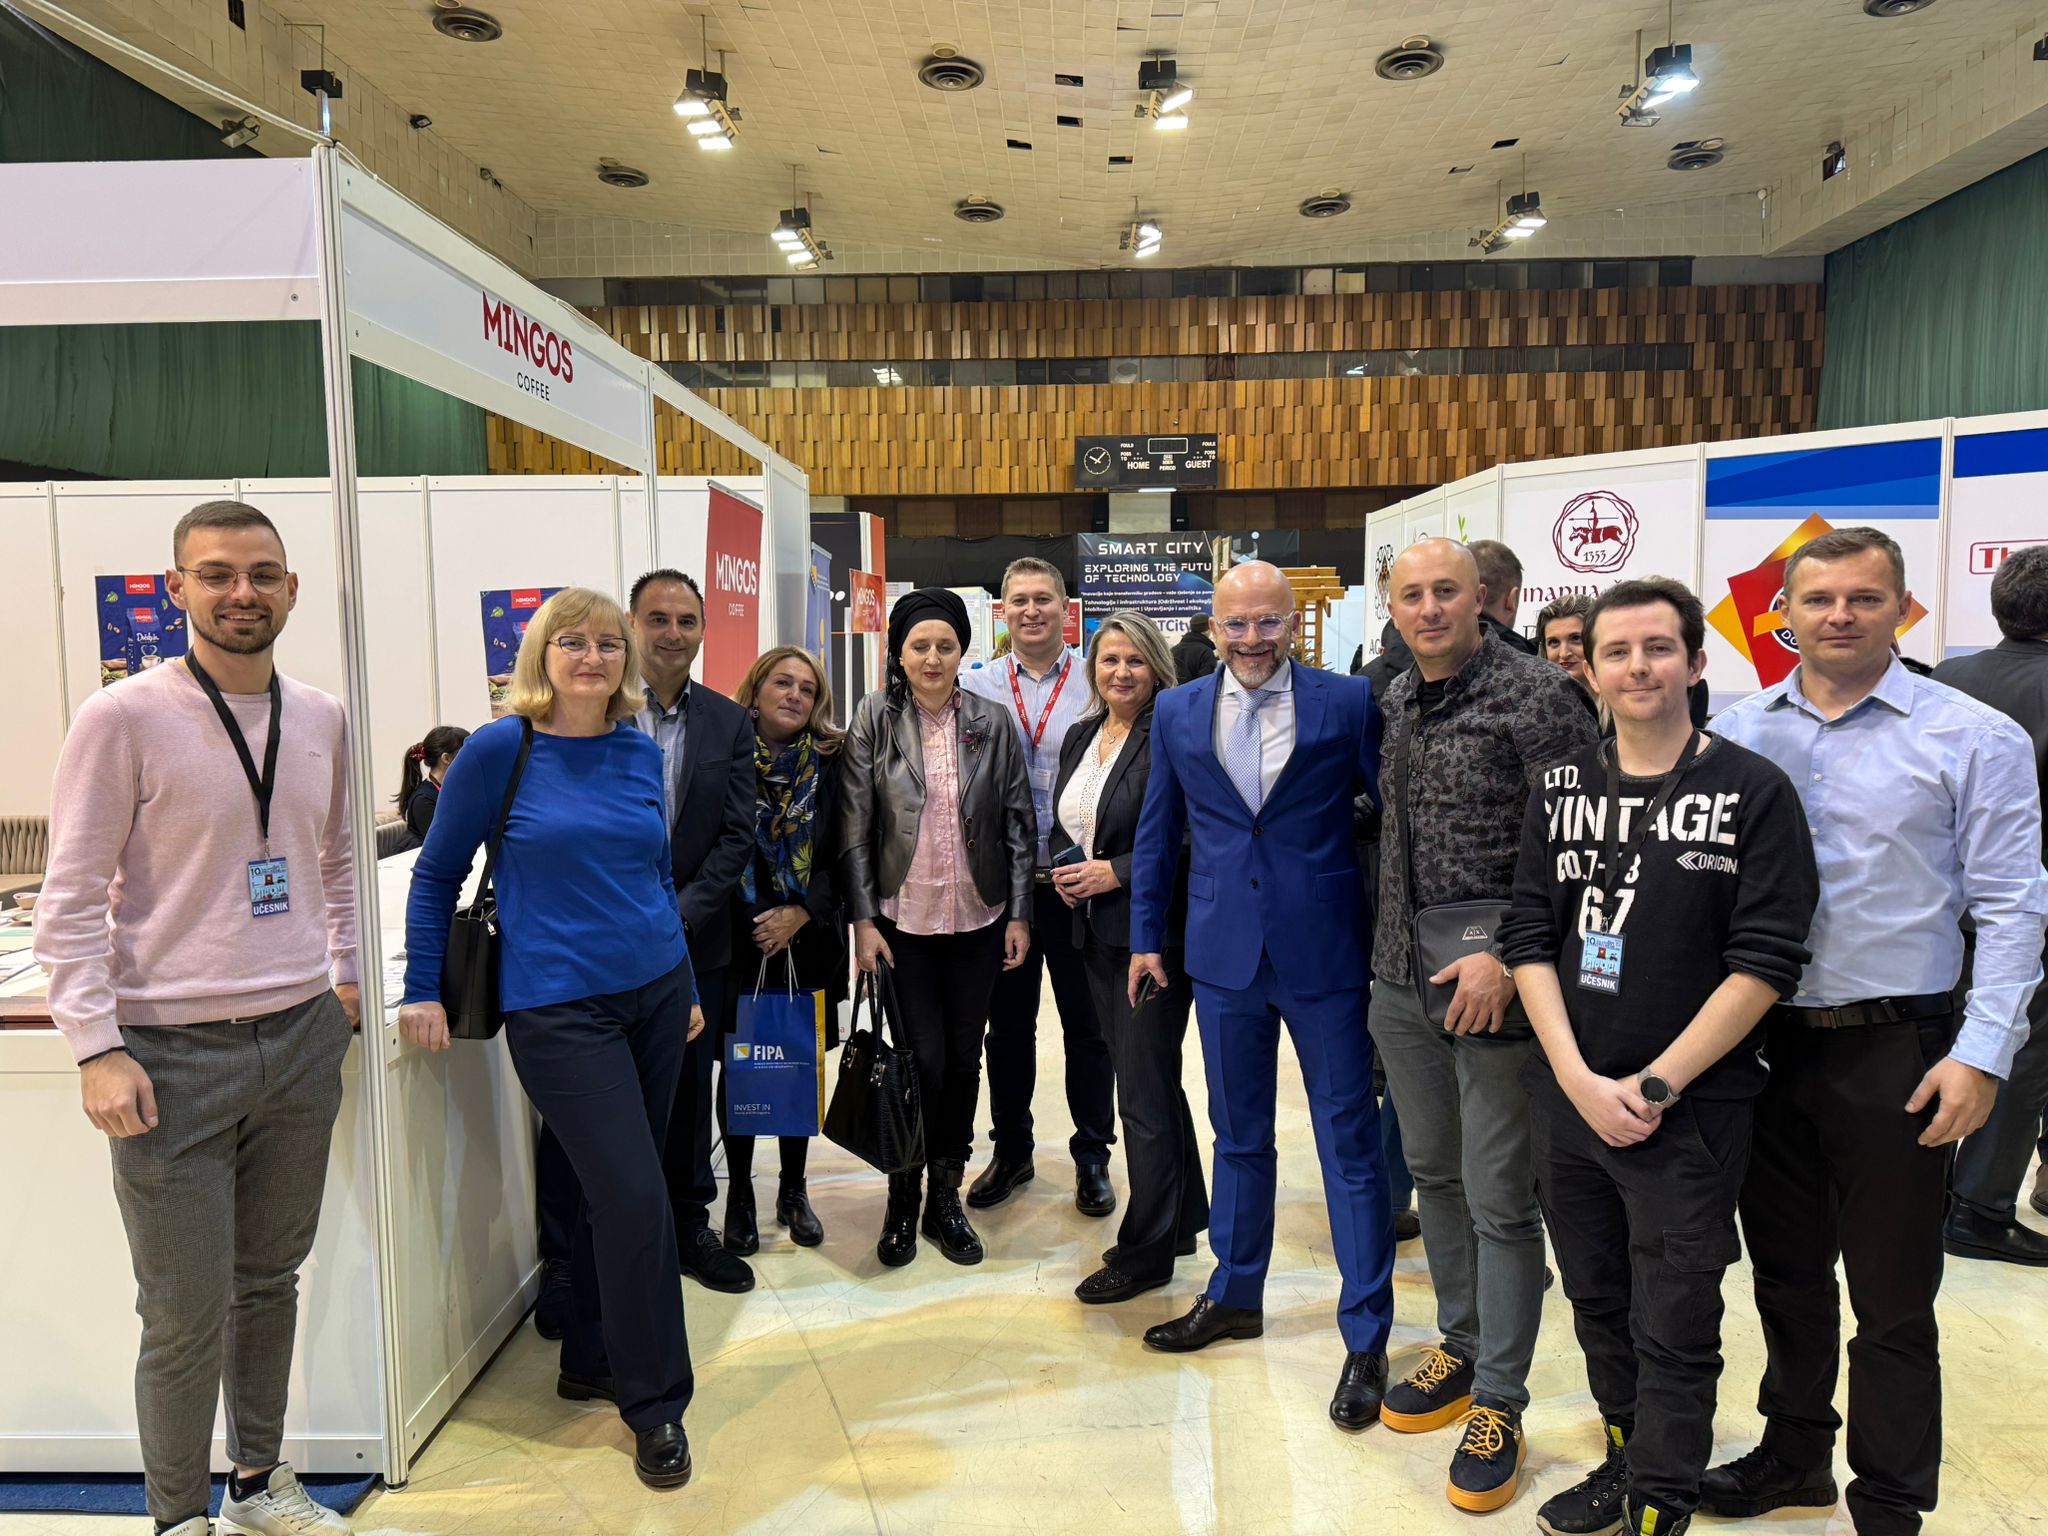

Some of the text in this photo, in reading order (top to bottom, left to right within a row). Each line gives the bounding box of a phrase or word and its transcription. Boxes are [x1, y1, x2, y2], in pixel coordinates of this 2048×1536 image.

[482, 290, 574, 384] MINGOS
[516, 371, 550, 402] COFFEE
[1127, 461, 1151, 470] HOME
[1185, 459, 1212, 469] GUEST
[1098, 541, 1204, 555] SMART CITY
[1583, 549, 1606, 563] 1353
[715, 551, 758, 596] MINGOS
[1084, 563, 1149, 574] EXPLORING
[1154, 562, 1176, 572] THE
[1084, 573, 1181, 583] OF TECHNOLOGY
[728, 603, 745, 617] COFFEE
[1158, 619, 1191, 632] TCity
[1544, 765, 1582, 790] LTD.
[1544, 792, 1741, 846] VINTAGE
[1698, 853, 1739, 875] ORIGIN
[253, 900, 289, 916] UČESNIK
[1578, 885, 1636, 942] 67
[1581, 973, 1617, 991] UČESNIK
[753, 1044, 785, 1061] FIPA
[733, 1103, 771, 1112] INVEST IN
